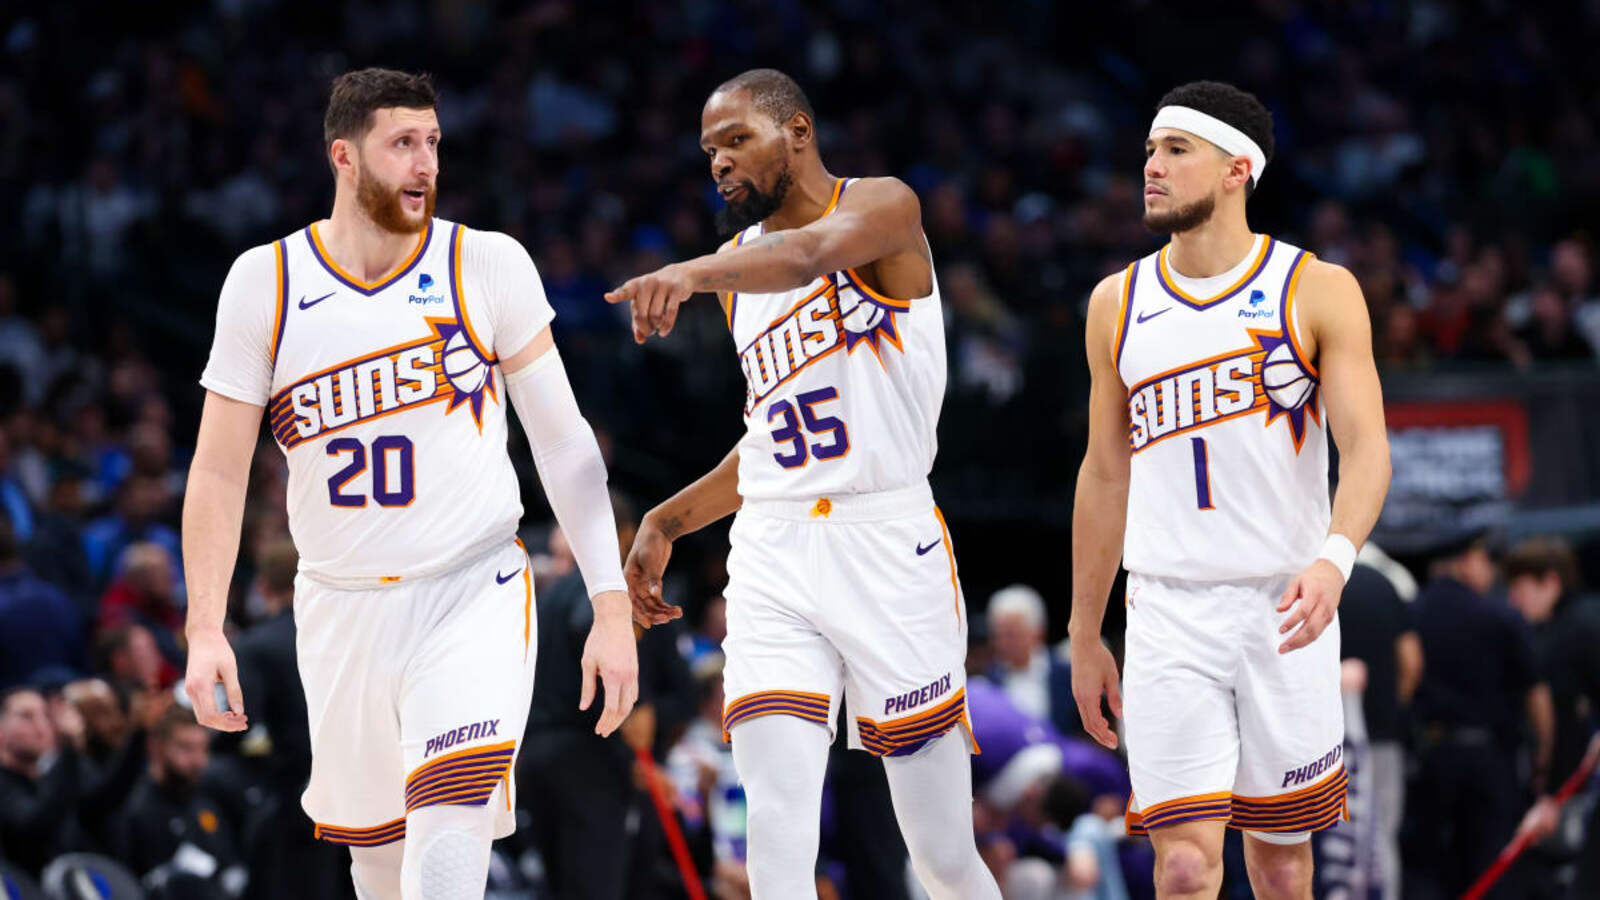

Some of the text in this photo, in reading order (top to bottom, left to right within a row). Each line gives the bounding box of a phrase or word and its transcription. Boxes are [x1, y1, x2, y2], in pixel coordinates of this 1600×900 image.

[408, 294, 444, 305] PayPal
[1238, 309, 1273, 319] PayPal
[741, 295, 839, 412] UNS
[290, 343, 437, 439] SUNS
[1130, 356, 1255, 449] SUNS
[767, 386, 851, 470] 35
[326, 435, 416, 508] 20
[1190, 437, 1216, 510] 1
[884, 671, 951, 715] PHOENIX
[424, 718, 500, 759] PHOENIX
